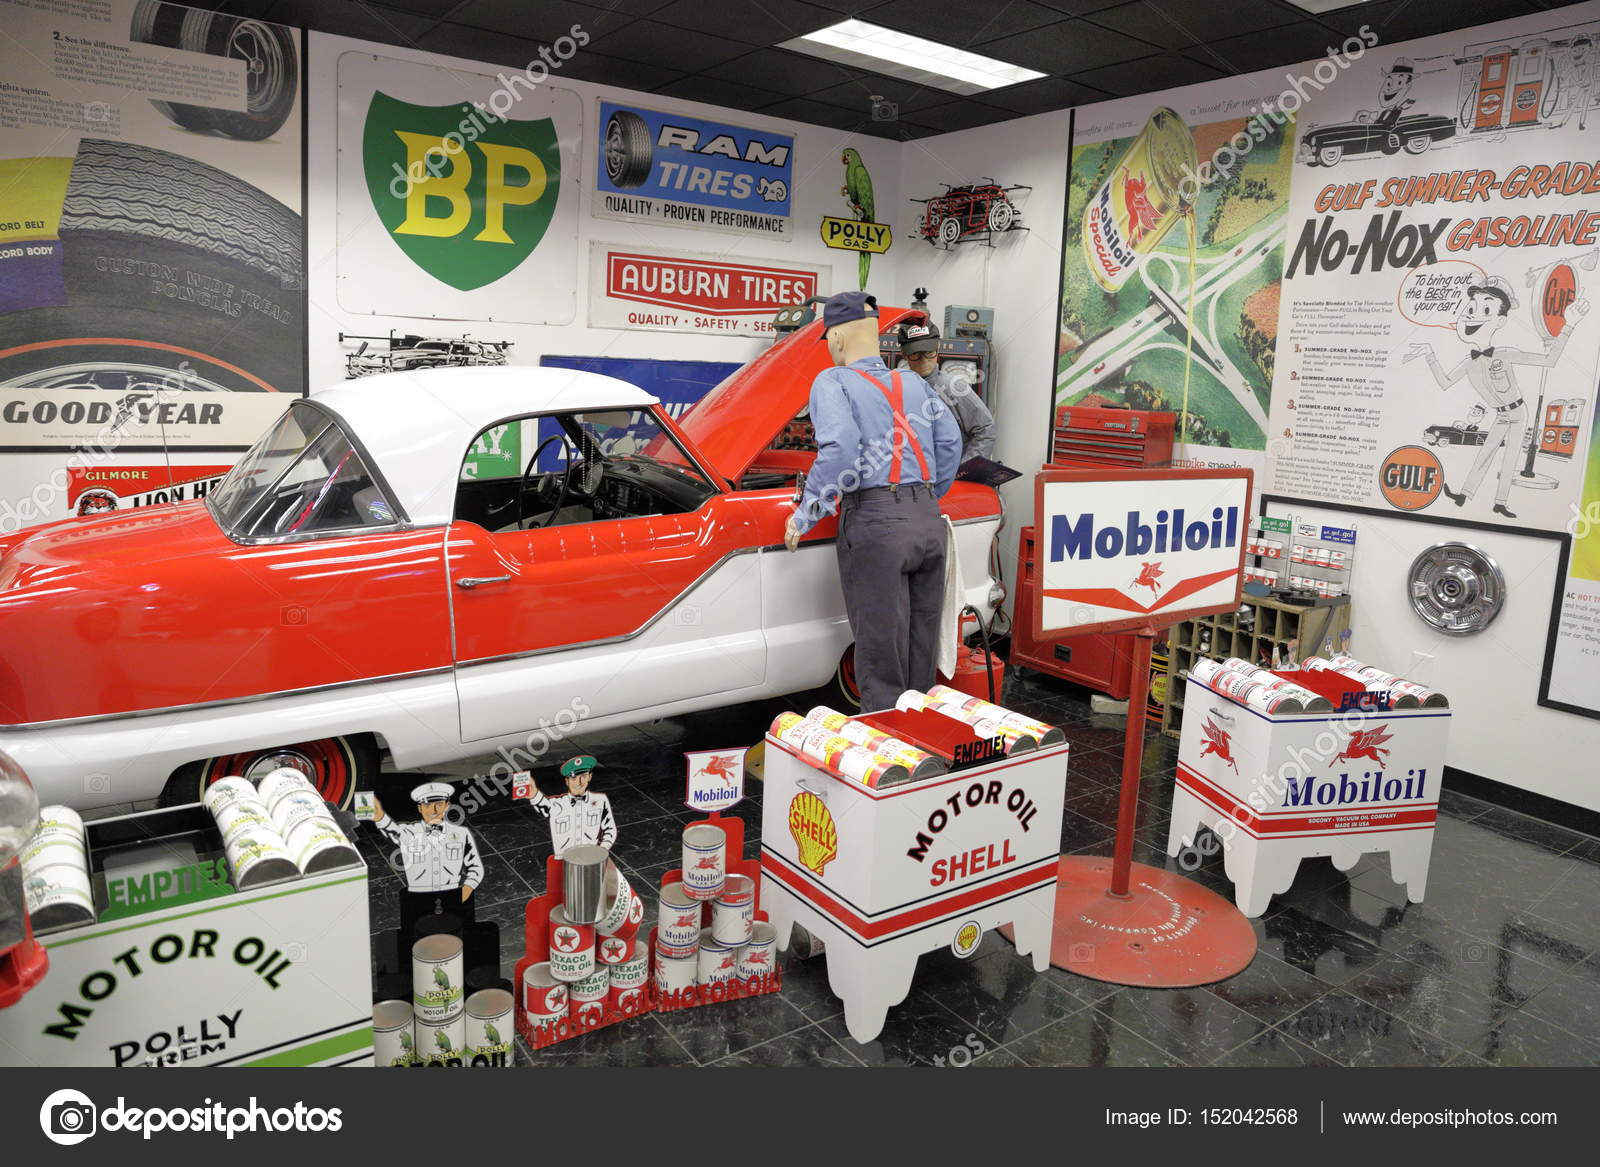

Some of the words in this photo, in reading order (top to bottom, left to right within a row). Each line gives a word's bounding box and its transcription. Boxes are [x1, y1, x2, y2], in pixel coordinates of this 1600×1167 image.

[53, 31, 63, 41] 2.
[65, 36, 77, 44] See
[80, 38, 92, 46] the
[656, 124, 790, 168] RAM
[393, 130, 547, 245] BP
[658, 161, 754, 200] TIRES
[1314, 179, 1377, 213] GULF
[1374, 160, 1600, 208] SUMMER-GRADE
[0, 221, 21, 232] ORD
[25, 220, 46, 231] BELT
[605, 195, 653, 216] QUALITY
[663, 204, 705, 223] PROVEN
[711, 210, 784, 233] PERFORMANCE
[1100, 182, 1136, 267] Mobiloil
[829, 220, 886, 246] POLLY
[842, 238, 870, 250] GAS
[1089, 206, 1122, 277] Special
[1446, 209, 1600, 252] GASOLINE
[27, 246, 53, 256] BODY
[96, 255, 177, 282] CUSTOM
[186, 270, 235, 299] WIDE
[240, 288, 293, 325] TREAD
[621, 264, 729, 298] AUBURN
[740, 275, 807, 306] TIRES
[1405, 287, 1422, 299] the
[1423, 288, 1451, 301] BEST
[1451, 286, 1462, 299] in
[1415, 274, 1426, 286] To
[1426, 274, 1450, 290] bring
[1453, 273, 1473, 286] out
[152, 280, 243, 318] POLYGLAS
[1414, 300, 1438, 316] your
[1437, 298, 1463, 315] car!
[628, 312, 678, 327] QUALITY
[694, 316, 739, 330] SAFETY
[85, 471, 149, 481] GILMORE
[1172, 458, 1205, 468] urnpike
[1383, 461, 1437, 493] GULF
[1050, 506, 1238, 562] Mobiloil
[1342, 690, 1391, 708] EMPTIES
[953, 735, 1006, 762] EMPTIES
[693, 786, 738, 803] Mobiloil
[1281, 769, 1427, 807] Mobiloil
[792, 811, 834, 852] SHELL
[906, 780, 1002, 863] MOTOR
[1007, 788, 1038, 833] OIL
[687, 871, 723, 882] Mobiloil
[930, 839, 1016, 888] SHELL
[108, 857, 229, 905] EMPTIES
[957, 931, 978, 942] SHELL
[578, 961, 592, 971] OIL
[614, 959, 648, 971] TEXACO
[43, 929, 219, 1041] MOTOR
[233, 936, 293, 991] OIL
[428, 988, 457, 999] POLLY
[109, 1009, 244, 1067] POLLY
[480, 1043, 506, 1053] POLLY
